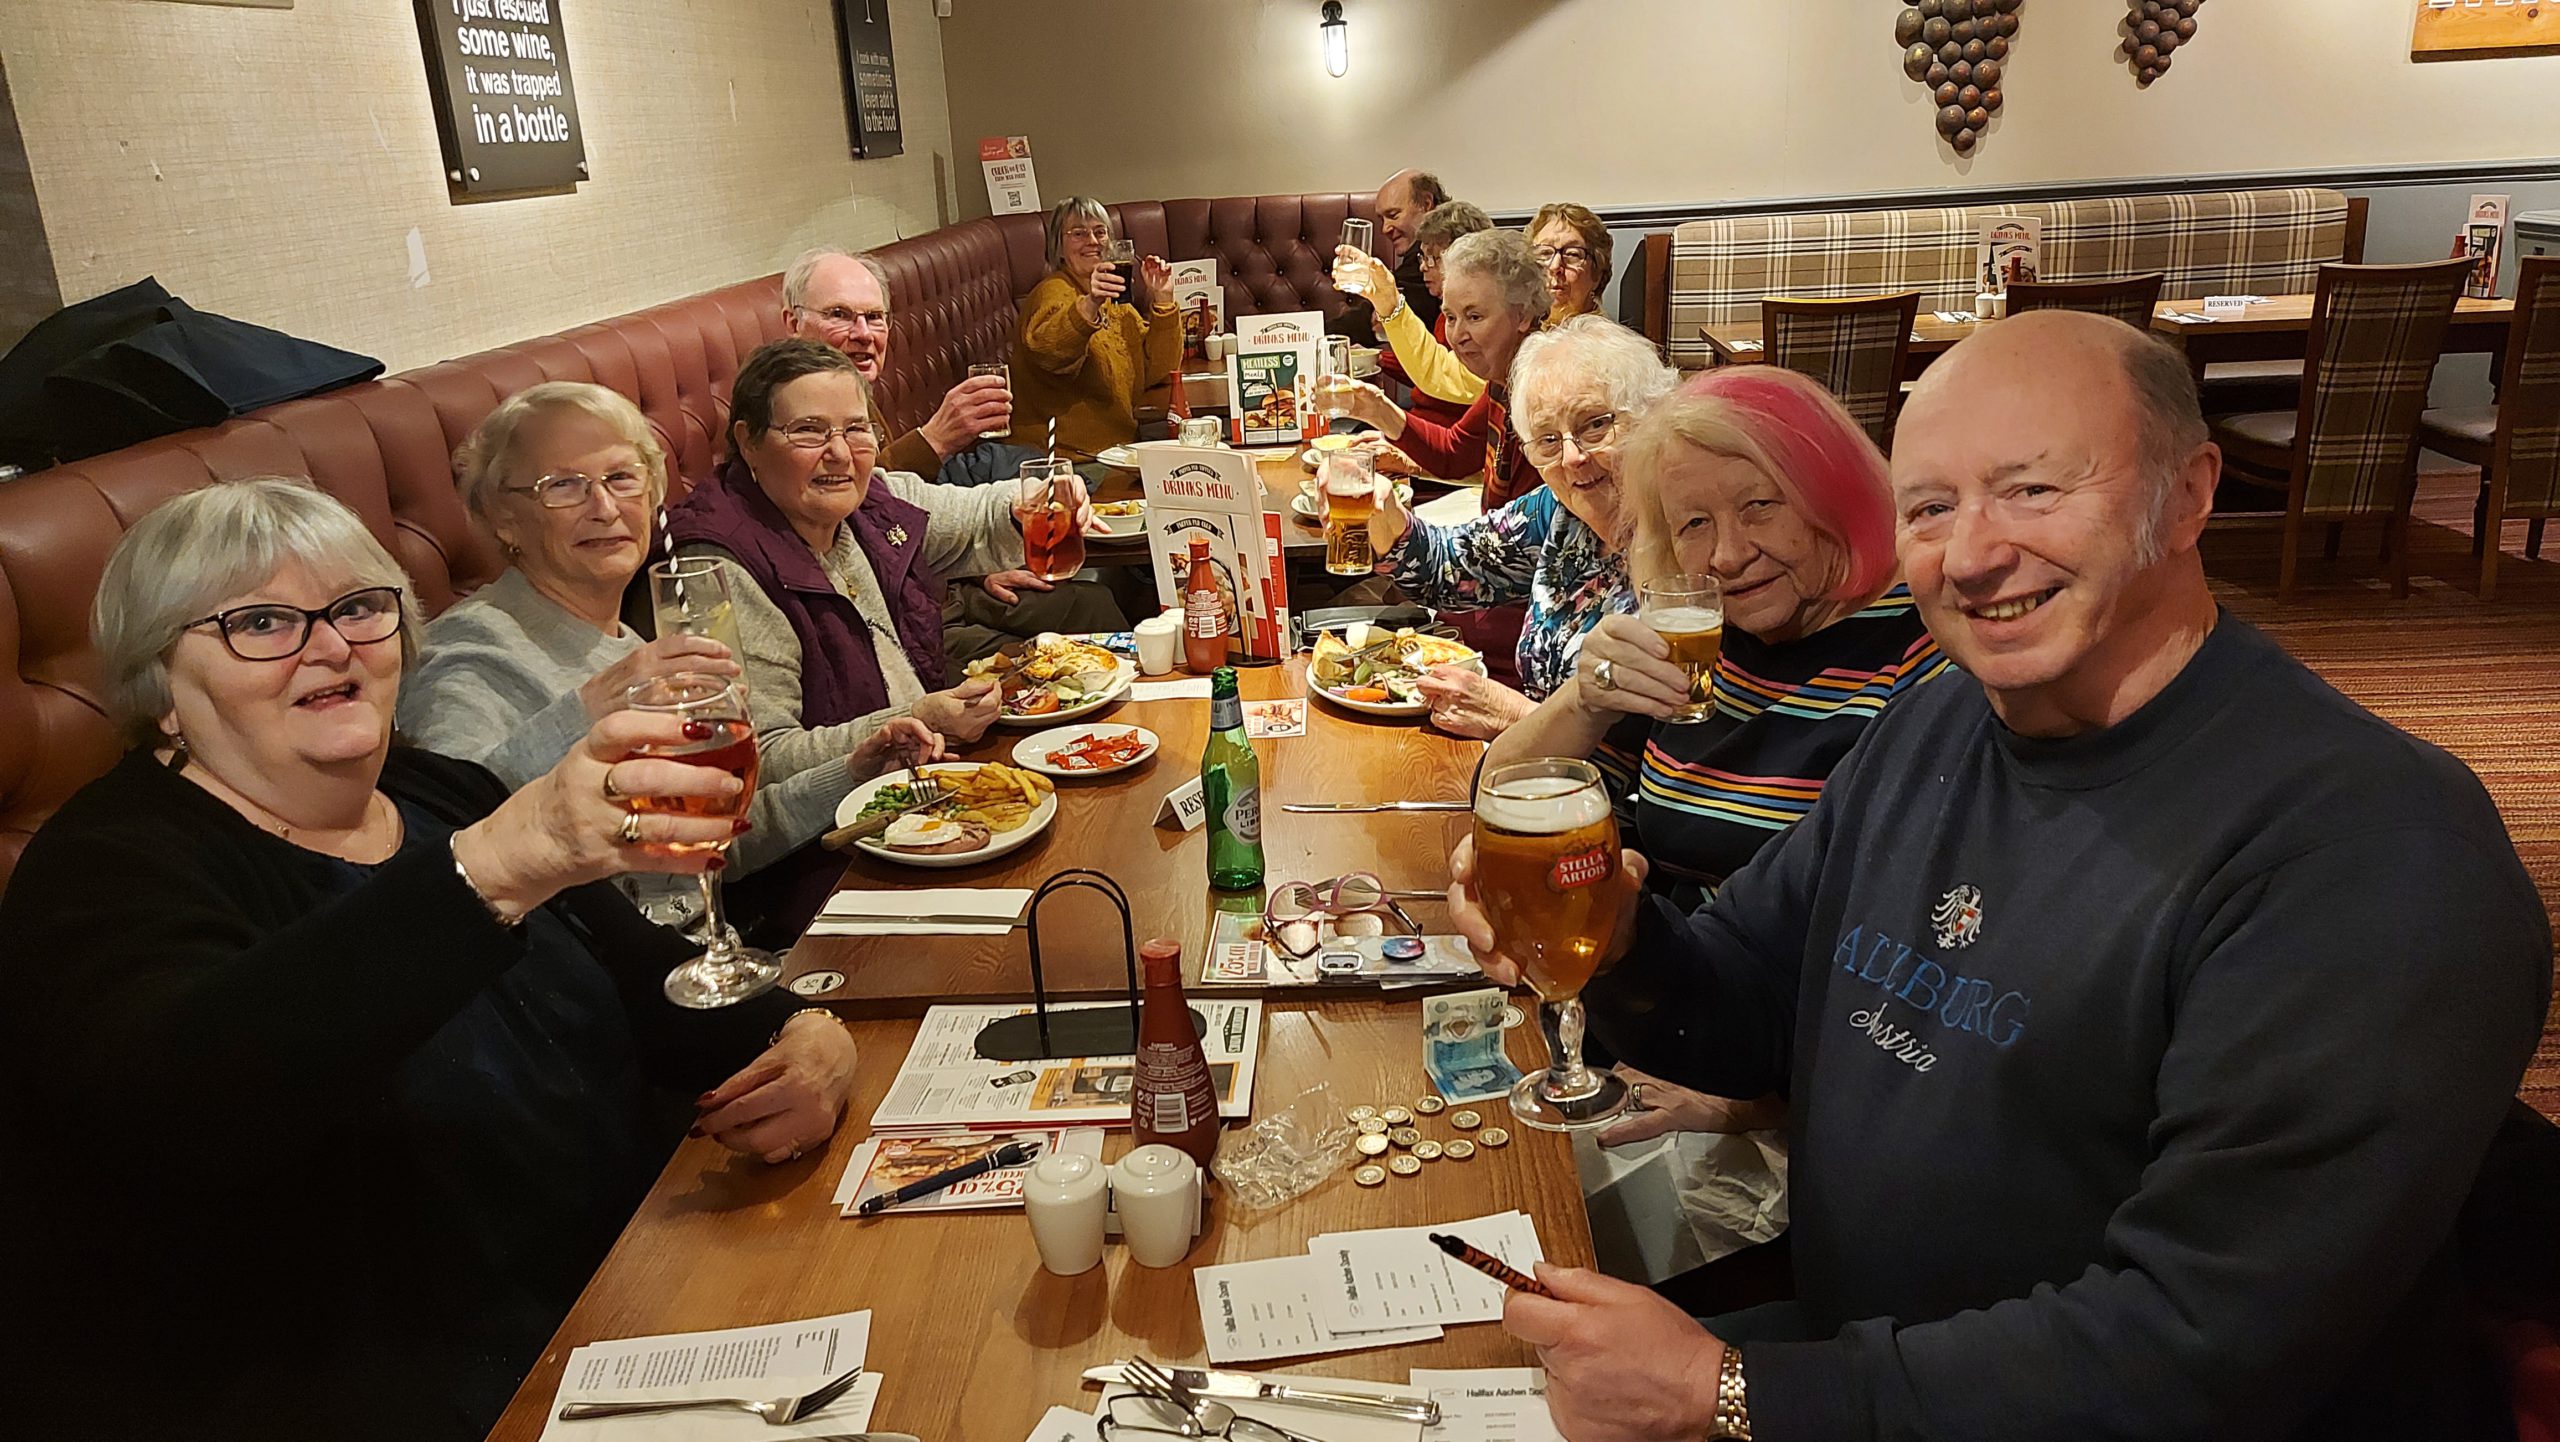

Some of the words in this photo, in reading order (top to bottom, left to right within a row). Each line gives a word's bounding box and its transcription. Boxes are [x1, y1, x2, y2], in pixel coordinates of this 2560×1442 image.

[493, 0, 550, 25] rescued
[457, 26, 511, 58] some
[511, 25, 556, 66] wine,
[464, 64, 480, 94] it
[480, 71, 511, 95] was
[511, 69, 563, 101] trapped
[865, 92, 879, 109] even
[879, 91, 890, 109] add
[472, 104, 498, 144] in
[498, 112, 515, 143] a
[513, 104, 570, 143] bottle
[864, 111, 872, 132] to
[872, 110, 882, 132] the
[882, 110, 897, 132] food
[2207, 300, 2243, 308] RESERVED
[1253, 333, 1285, 345] DRINKS
[1287, 332, 1311, 343] MENU
[1243, 355, 1279, 369] MEATLESS
[1163, 479, 1204, 498] DRINKS
[1206, 482, 1234, 500] MENU
[1560, 853, 1604, 873] STELLA
[1561, 866, 1606, 885] ARTOIS
[1833, 924, 2031, 1048] ALZBURG
[1850, 1002, 1937, 1072] Austria
[949, 1182, 978, 1196] OFF
[1466, 1388, 1494, 1398] Halifax
[1496, 1388, 1526, 1397] Aachen
[1528, 1387, 1545, 1397] Soc
